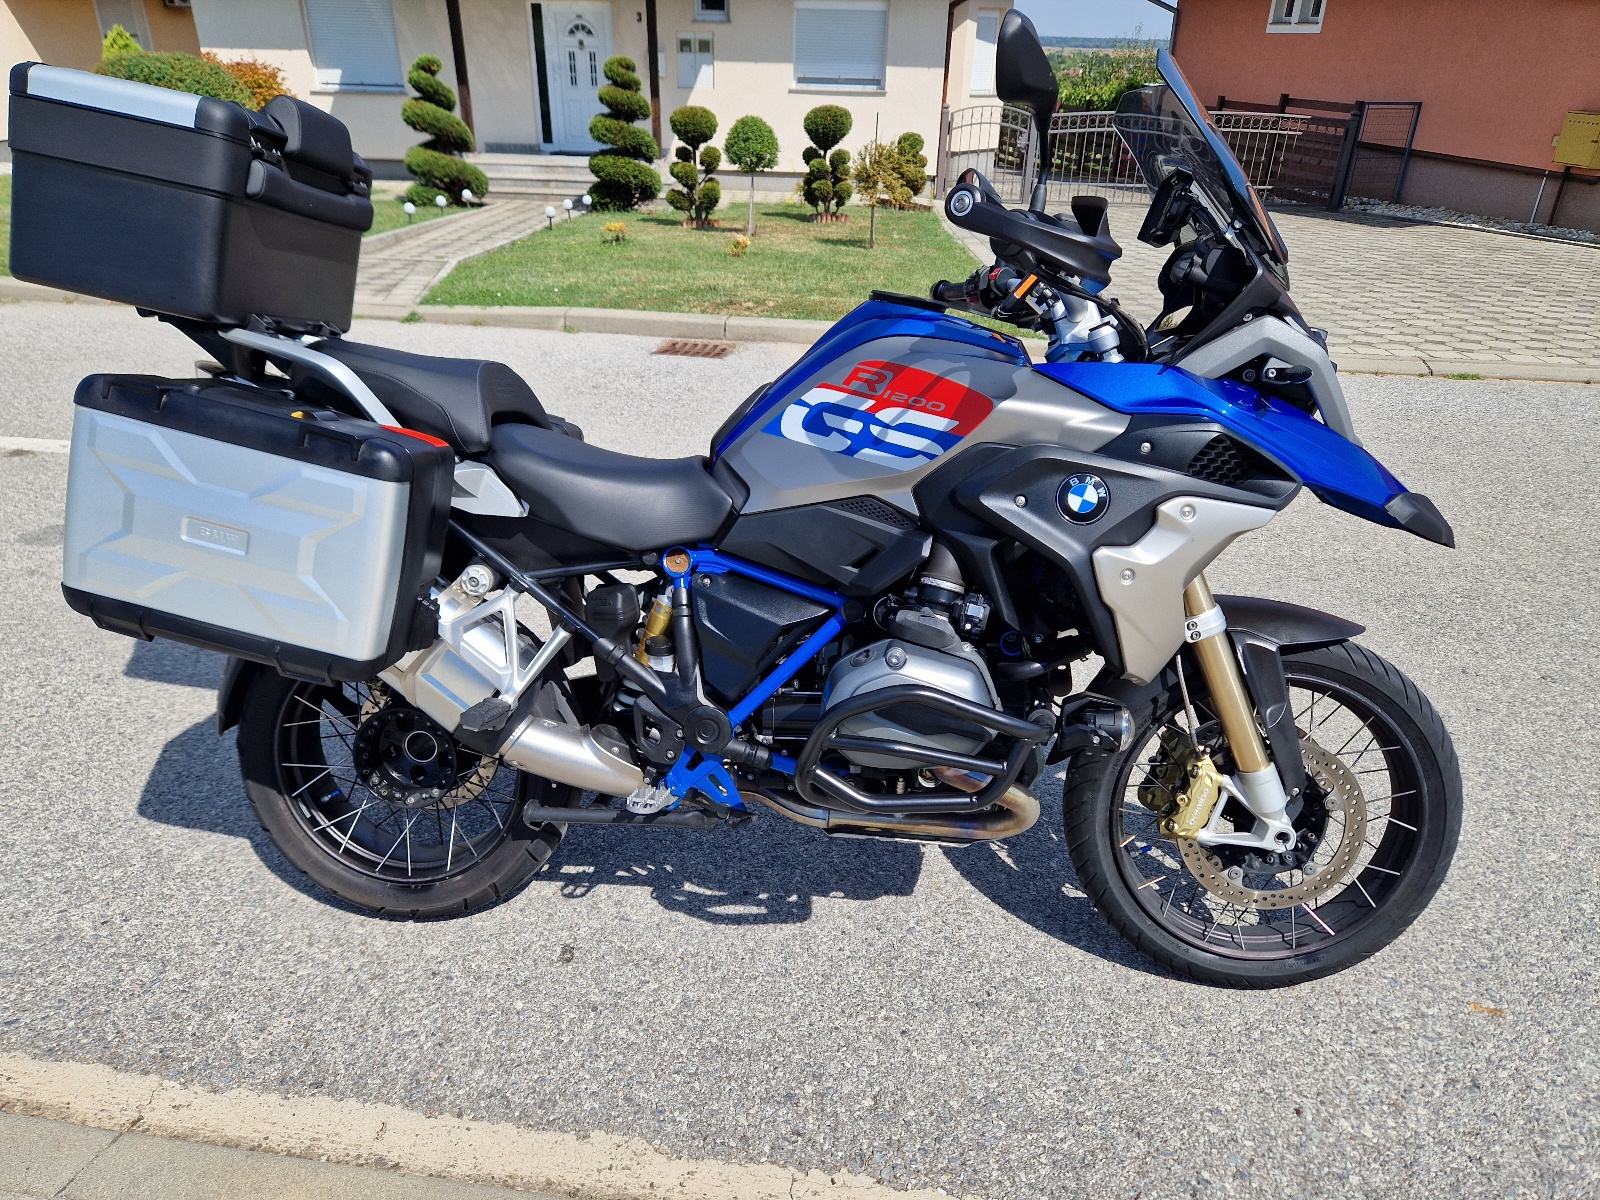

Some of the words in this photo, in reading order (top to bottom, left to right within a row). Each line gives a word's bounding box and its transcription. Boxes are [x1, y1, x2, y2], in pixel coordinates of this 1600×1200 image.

[635, 11, 642, 23] 3
[843, 366, 889, 394] R
[882, 390, 945, 411] 1200
[780, 387, 960, 471] GS
[1069, 475, 1107, 498] BMW
